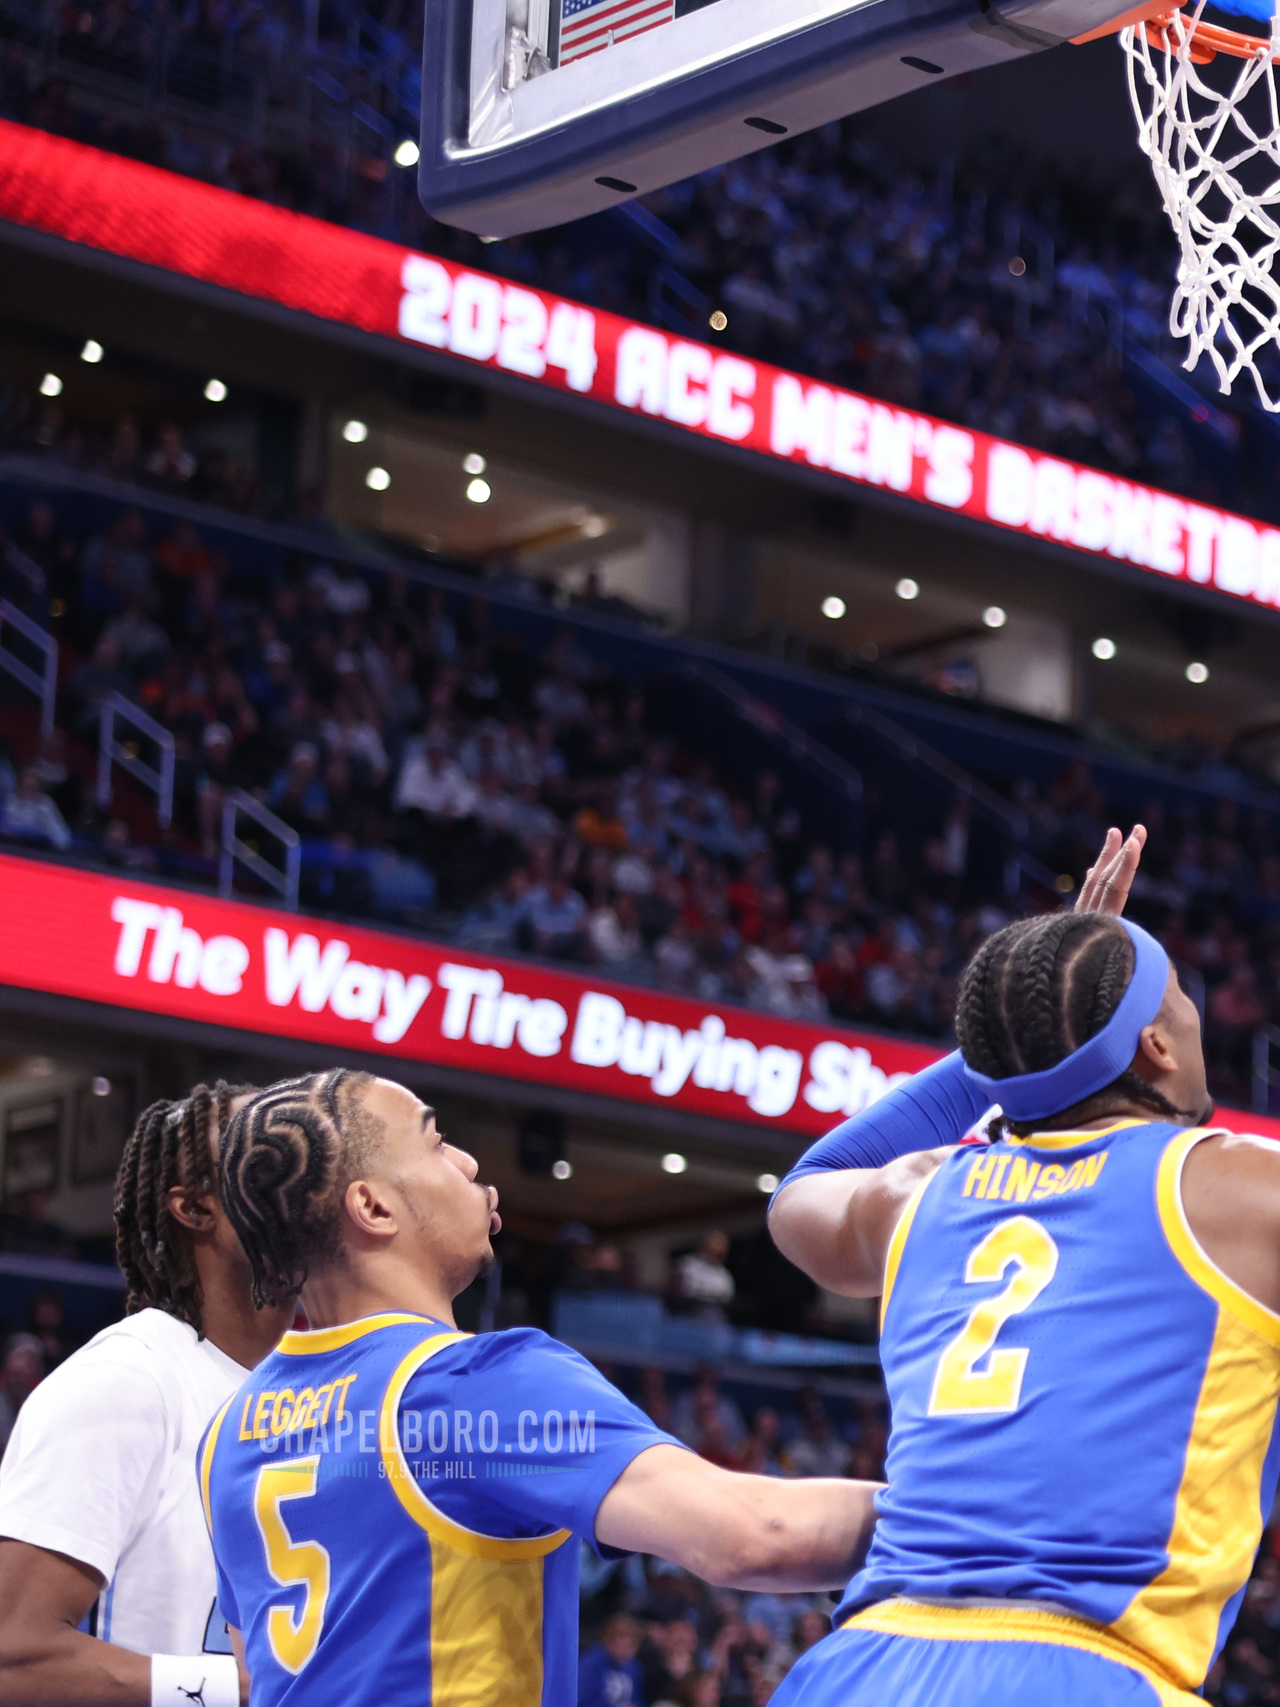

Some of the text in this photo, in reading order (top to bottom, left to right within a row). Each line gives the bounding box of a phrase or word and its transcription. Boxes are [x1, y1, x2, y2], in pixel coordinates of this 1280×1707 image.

[398, 253, 598, 393] 2024
[614, 326, 757, 441] ACC
[770, 374, 975, 508] MEN'S
[110, 896, 250, 996] The
[263, 927, 432, 1044] Way
[437, 962, 567, 1057] Tire
[571, 990, 803, 1117] Buying
[962, 1151, 1109, 1203] HINSON
[238, 1373, 358, 1442] LEGGETT
[927, 1215, 1059, 1416] 2
[254, 1454, 331, 1676] 5
